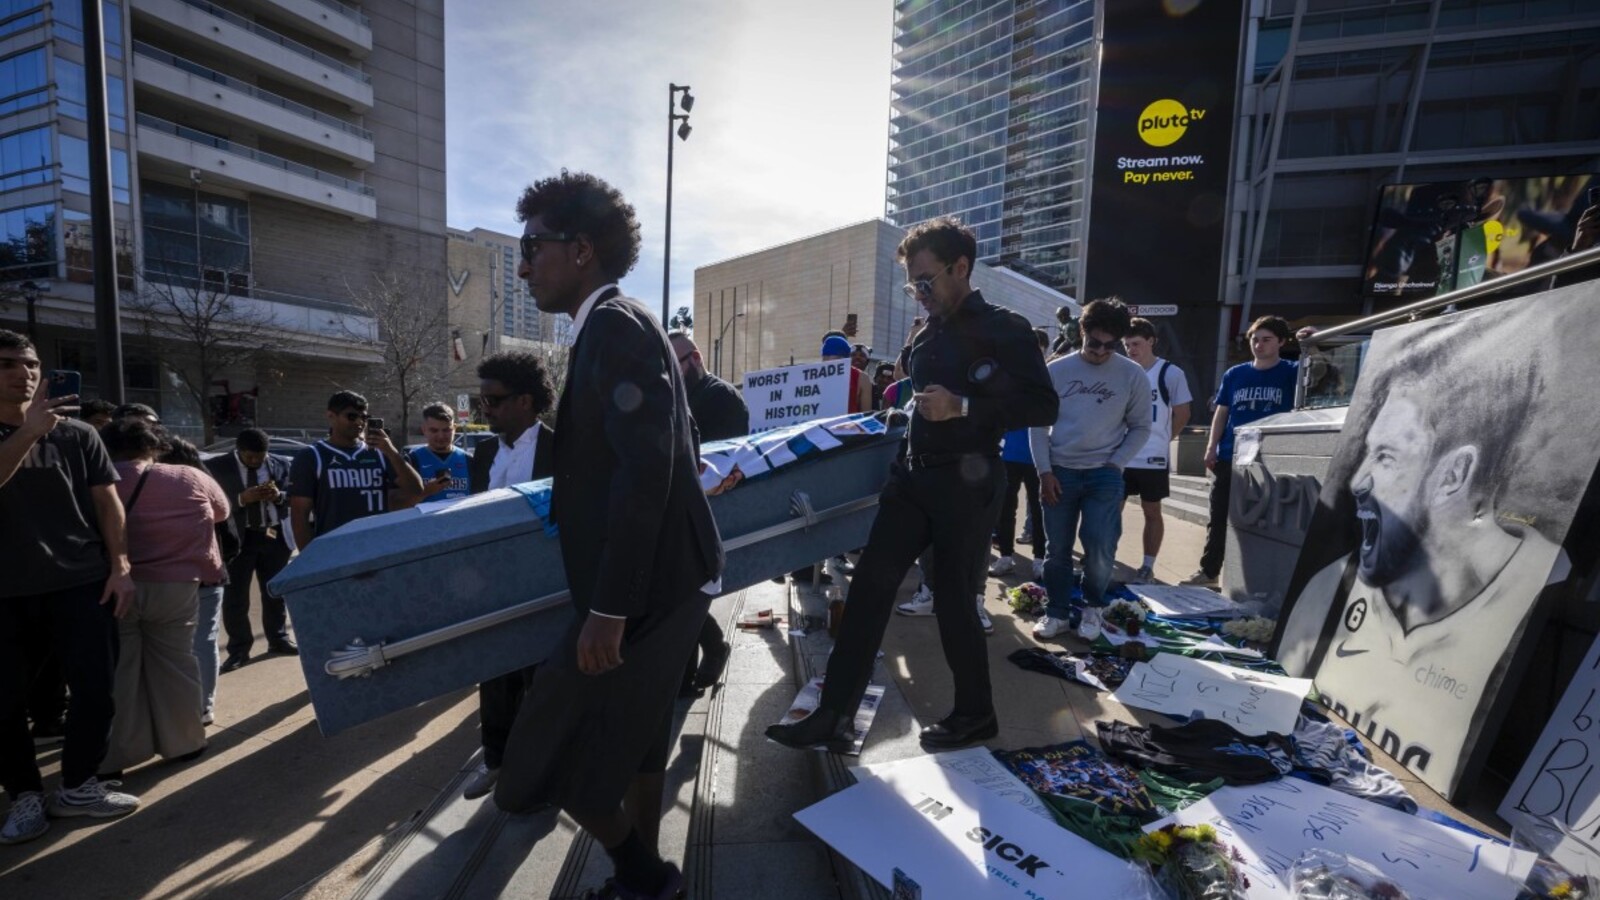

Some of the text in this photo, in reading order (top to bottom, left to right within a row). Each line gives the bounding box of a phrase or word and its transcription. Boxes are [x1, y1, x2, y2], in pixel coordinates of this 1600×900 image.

[1190, 108, 1206, 120] tv
[1117, 154, 1204, 170] Stream now.
[1124, 169, 1194, 185] Pay never.
[1139, 306, 1176, 315] OUTDOOR
[748, 363, 845, 388] WORST TRADE
[769, 384, 821, 402] IN NBA
[1062, 380, 1116, 400] Dallas
[764, 403, 820, 420] HISTORY
[359, 490, 384, 512] 77
[1414, 663, 1469, 700] chime
